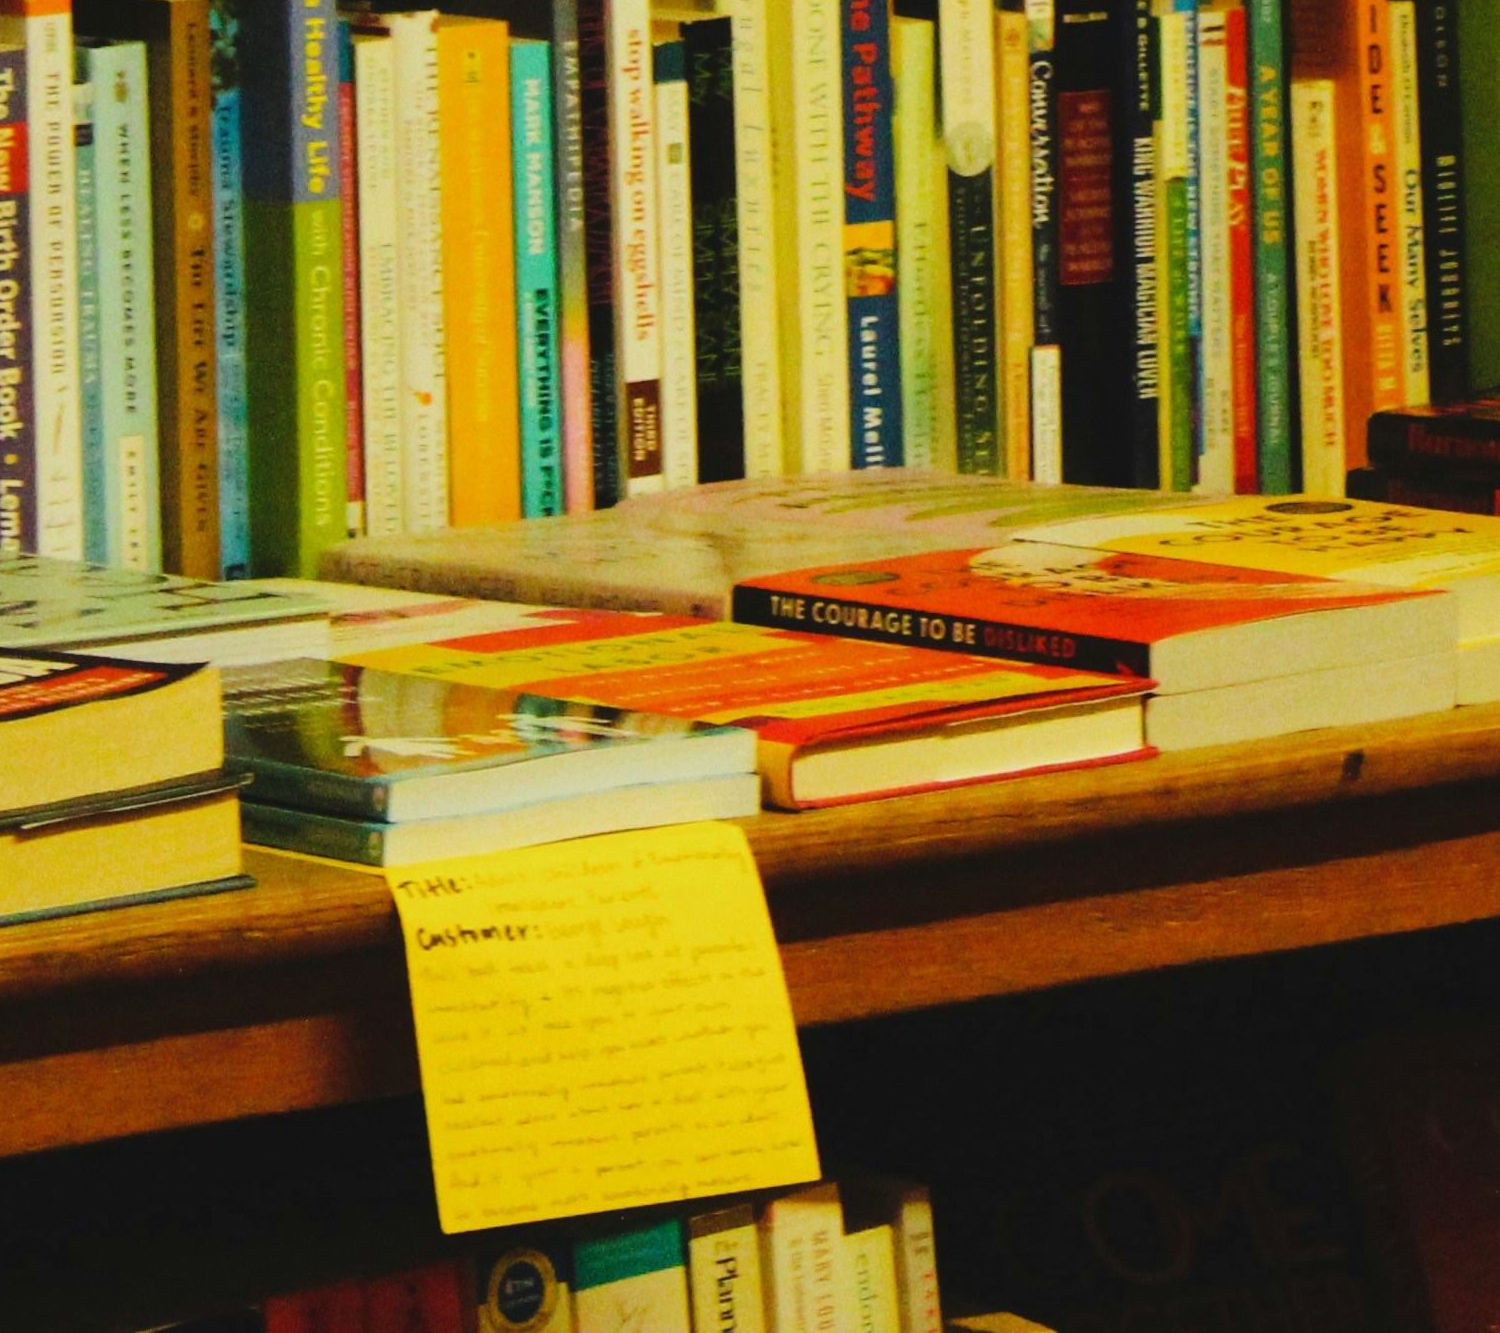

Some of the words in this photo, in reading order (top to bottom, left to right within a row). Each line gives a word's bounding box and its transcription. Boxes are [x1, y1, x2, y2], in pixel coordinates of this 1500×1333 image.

[301, 17, 329, 131] Healthy
[621, 27, 647, 78] stop
[307, 140, 328, 193] Life
[621, 82, 650, 187] walking
[845, 43, 878, 201] Pathway
[1028, 61, 1053, 229] Conversation
[309, 209, 329, 255] with
[627, 190, 647, 223] on
[308, 265, 331, 369] Chronic
[624, 229, 659, 342] eggshells
[312, 379, 337, 525] Conditions
[769, 594, 805, 623] THE
[811, 602, 913, 638] COURAGE
[919, 614, 947, 638] TO
[953, 618, 977, 645] BE
